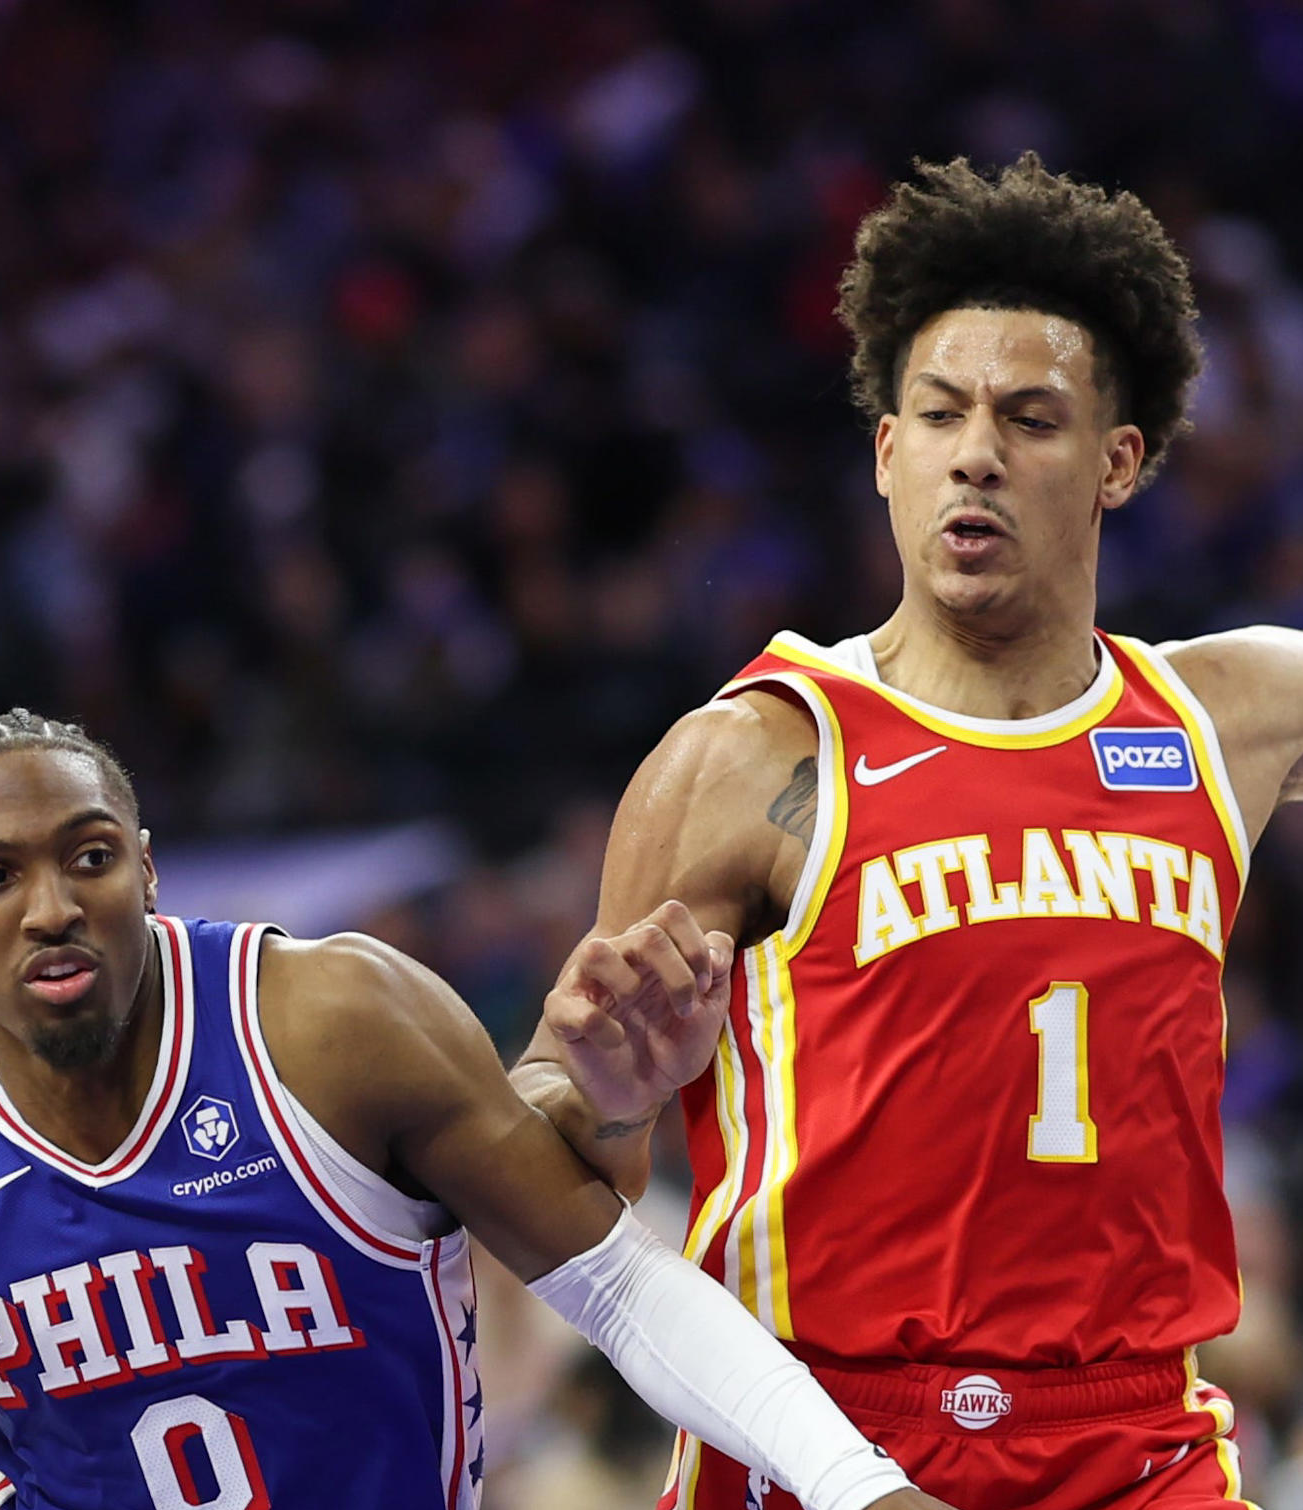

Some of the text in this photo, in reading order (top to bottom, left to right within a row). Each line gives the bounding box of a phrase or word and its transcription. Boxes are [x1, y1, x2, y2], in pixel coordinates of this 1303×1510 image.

[1102, 745, 1183, 774] paze
[853, 828, 1224, 968] ATLANTA
[1026, 981, 1098, 1163] 1
[172, 1156, 278, 1196] crypto.com
[942, 1391, 1012, 1414] HAWKS
